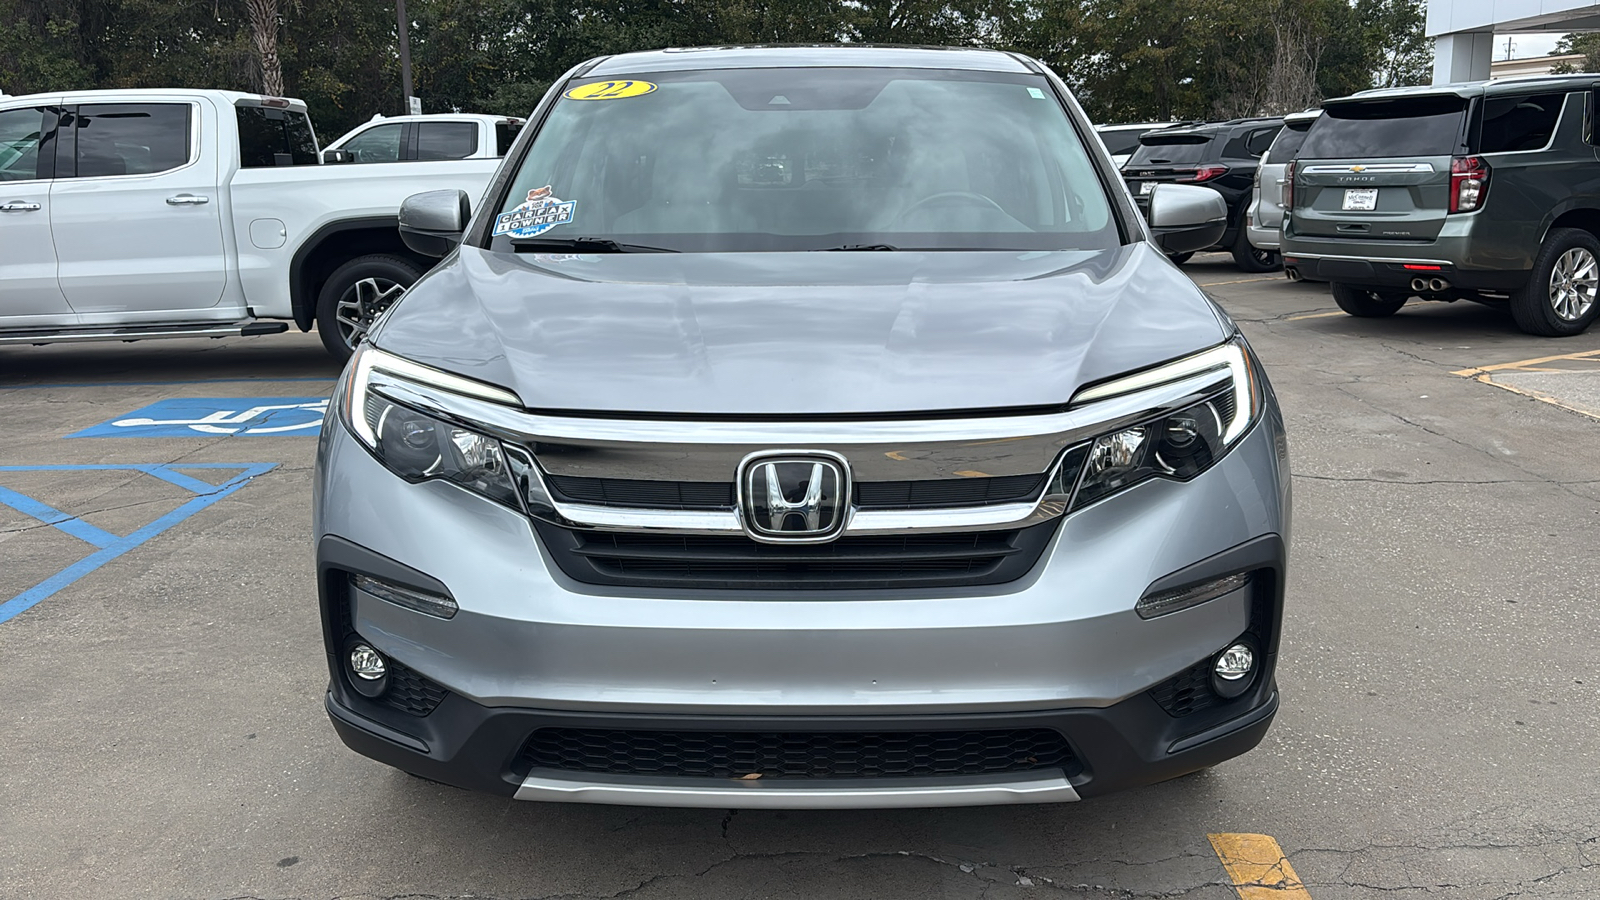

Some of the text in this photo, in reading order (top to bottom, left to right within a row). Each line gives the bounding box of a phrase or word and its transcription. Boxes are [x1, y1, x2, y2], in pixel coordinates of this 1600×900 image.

[583, 82, 633, 98] 22
[501, 206, 569, 223] CARFAX
[510, 213, 568, 229] OWNER
